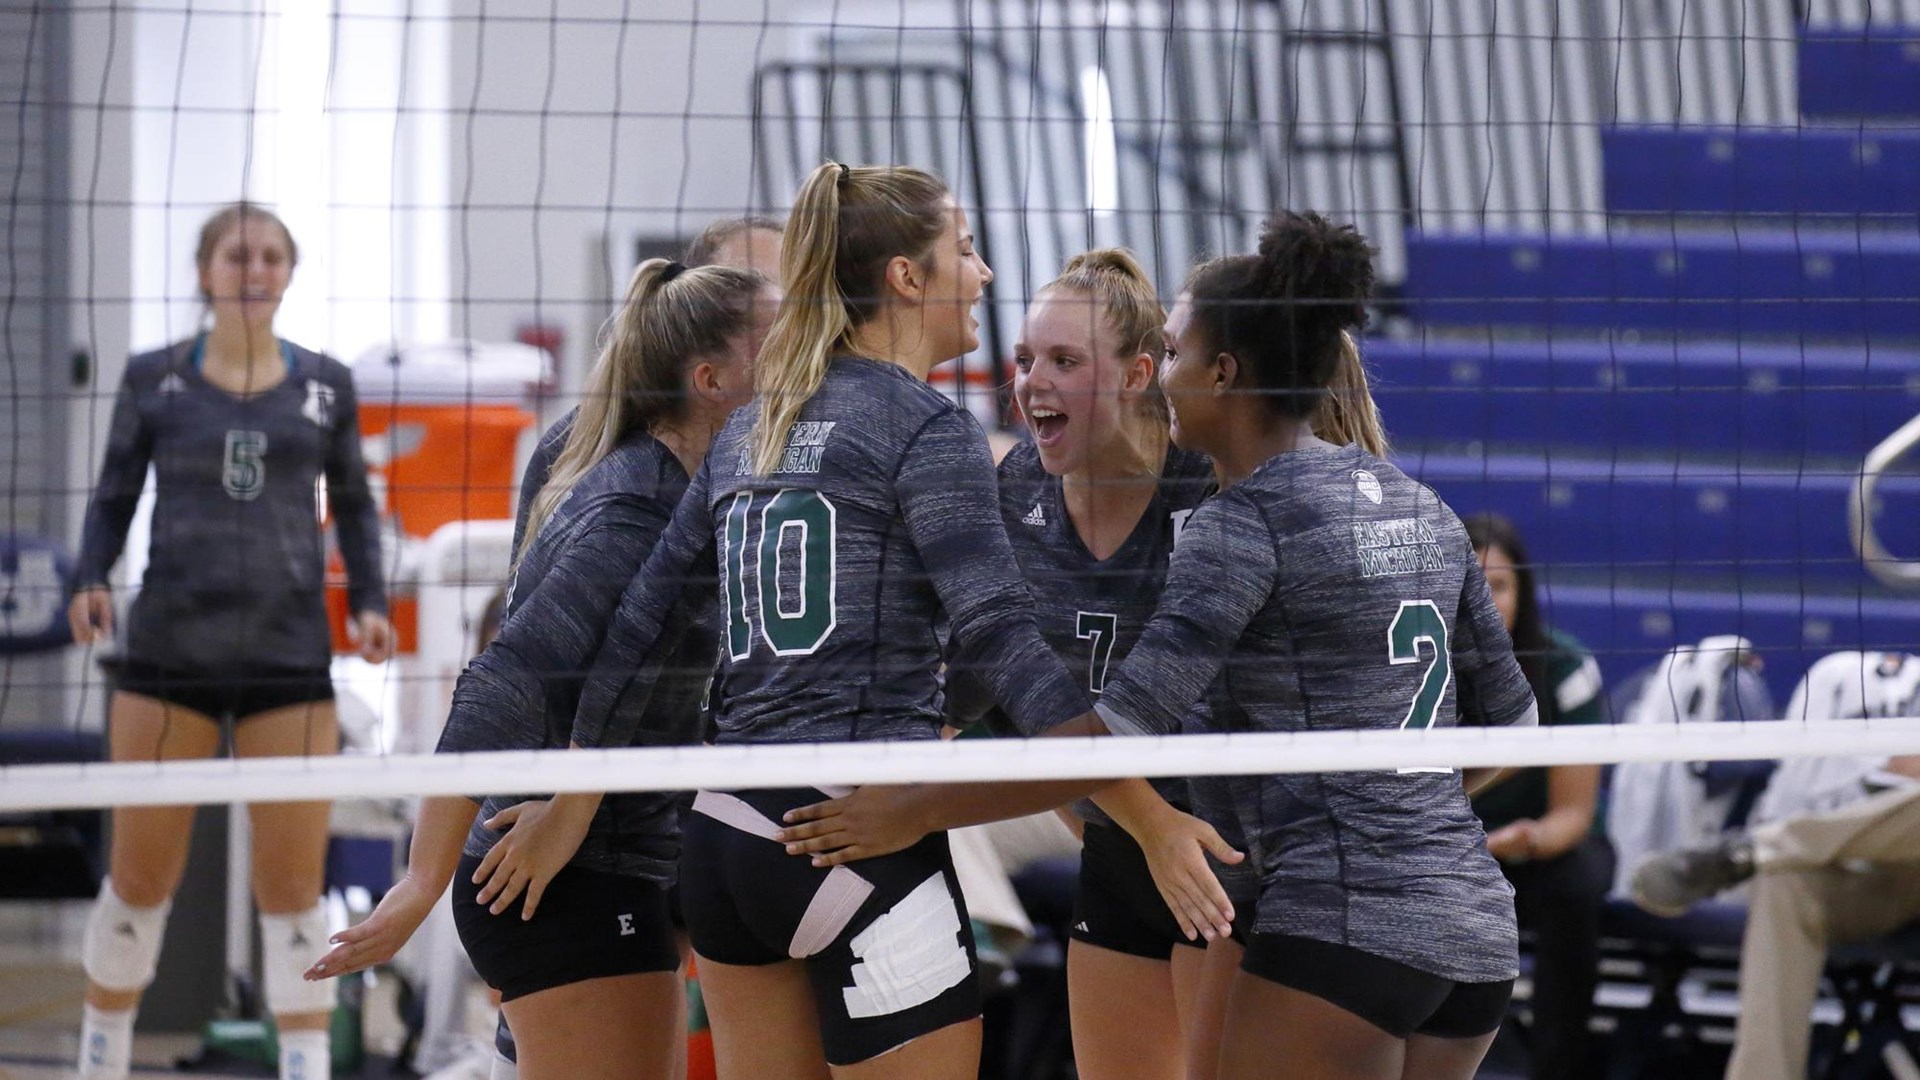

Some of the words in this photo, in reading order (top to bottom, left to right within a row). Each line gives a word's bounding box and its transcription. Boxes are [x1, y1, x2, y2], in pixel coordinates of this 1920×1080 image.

[223, 430, 268, 500] 5
[1022, 517, 1046, 526] adidas
[1350, 518, 1436, 548] EASTERN
[725, 487, 836, 662] 10
[1357, 544, 1445, 577] MICHIGAN
[1076, 611, 1117, 693] 7
[1388, 599, 1453, 774] 2
[618, 913, 636, 936] E
